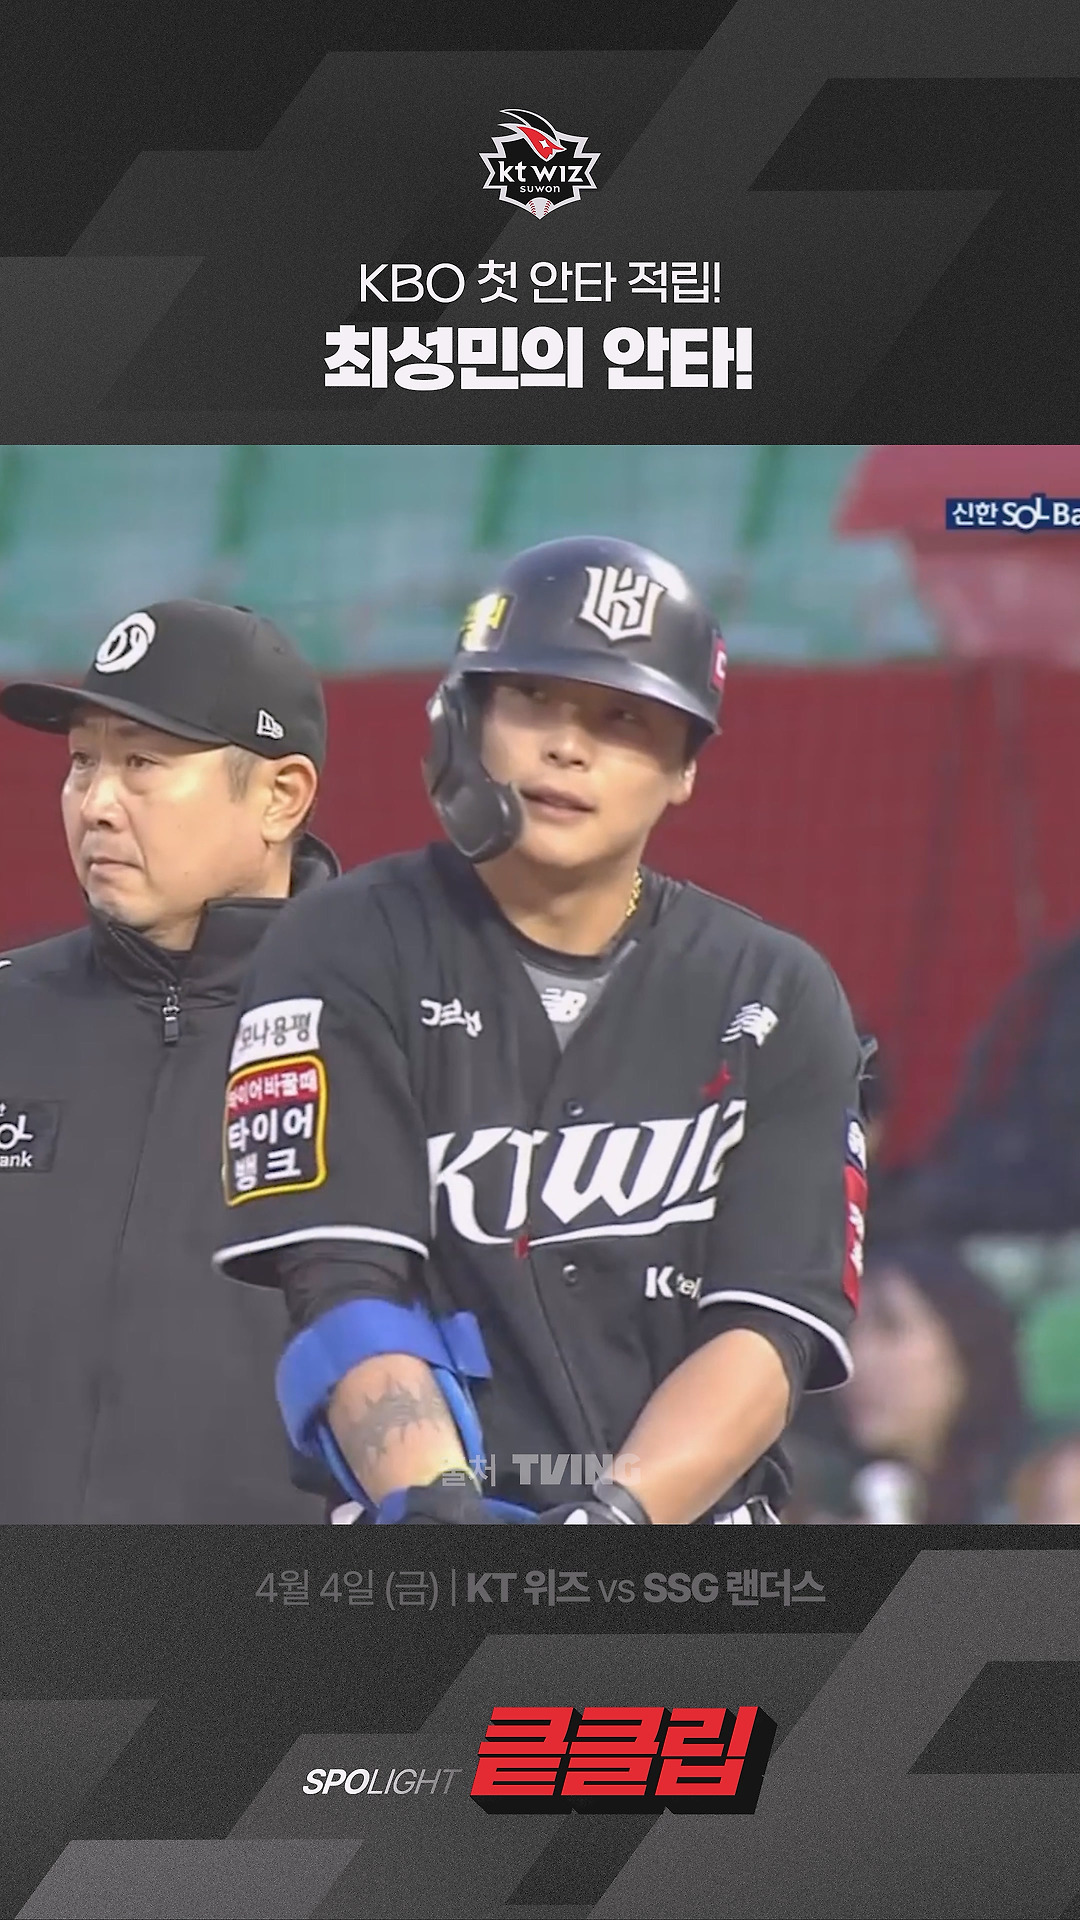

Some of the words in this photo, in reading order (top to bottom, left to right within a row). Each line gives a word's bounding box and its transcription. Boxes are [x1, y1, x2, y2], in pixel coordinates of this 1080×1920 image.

[228, 1103, 315, 1152] 타이어
[0, 1150, 33, 1167] ank
[235, 1148, 302, 1191] 뱅크
